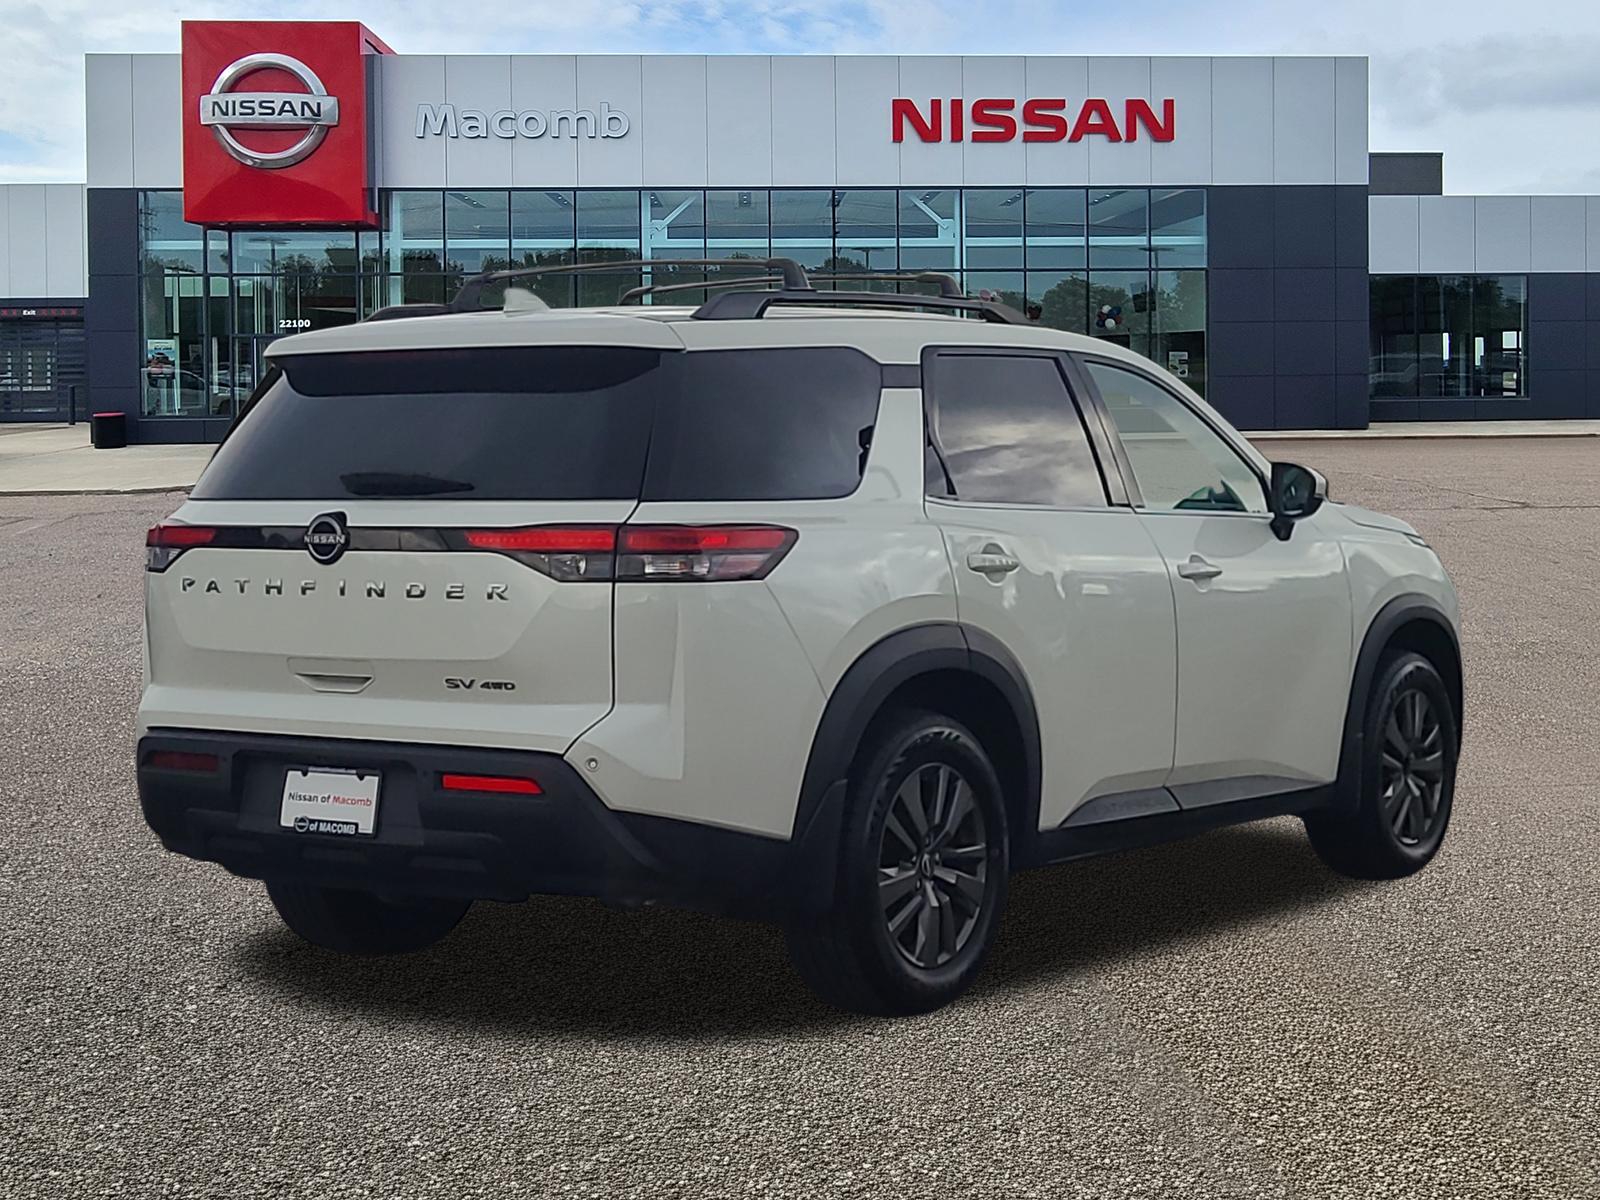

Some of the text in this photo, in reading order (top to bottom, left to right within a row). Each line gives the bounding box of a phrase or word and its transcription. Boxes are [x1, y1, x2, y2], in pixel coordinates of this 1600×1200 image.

[211, 100, 322, 117] NISSAN
[415, 102, 630, 139] Macomb
[892, 98, 1175, 143] NISSAN
[279, 319, 311, 328] 22100
[303, 534, 346, 545] NISSAN
[181, 577, 509, 600] PATHFINDER
[444, 678, 516, 691] SV 4WD
[288, 792, 372, 806] Nissan of Macomb
[309, 821, 356, 834] of MACOMB
